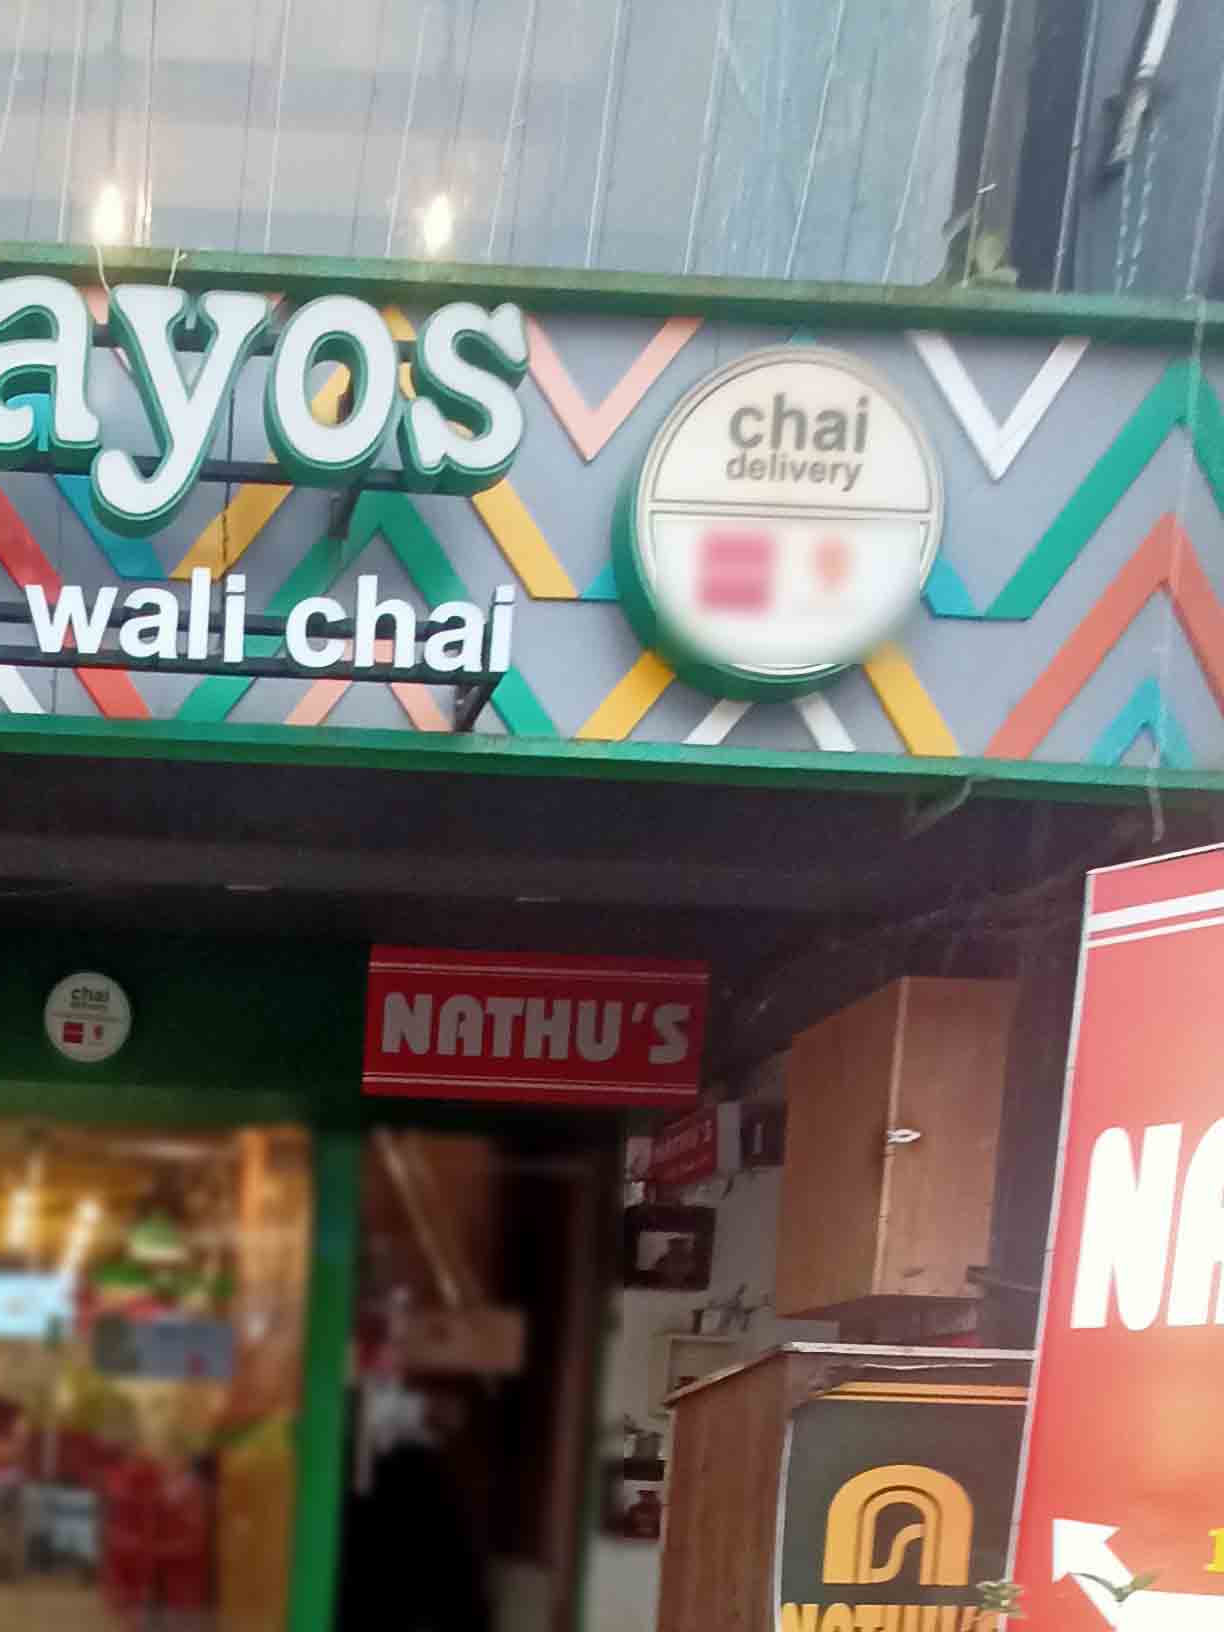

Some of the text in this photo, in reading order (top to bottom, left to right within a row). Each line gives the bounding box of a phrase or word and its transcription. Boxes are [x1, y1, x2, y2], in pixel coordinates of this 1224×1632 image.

[729, 392, 869, 454] chai
[725, 452, 864, 493] delivery
[24, 567, 247, 663] wali
[284, 574, 516, 674] chai
[380, 991, 693, 1065] NATHU'S
